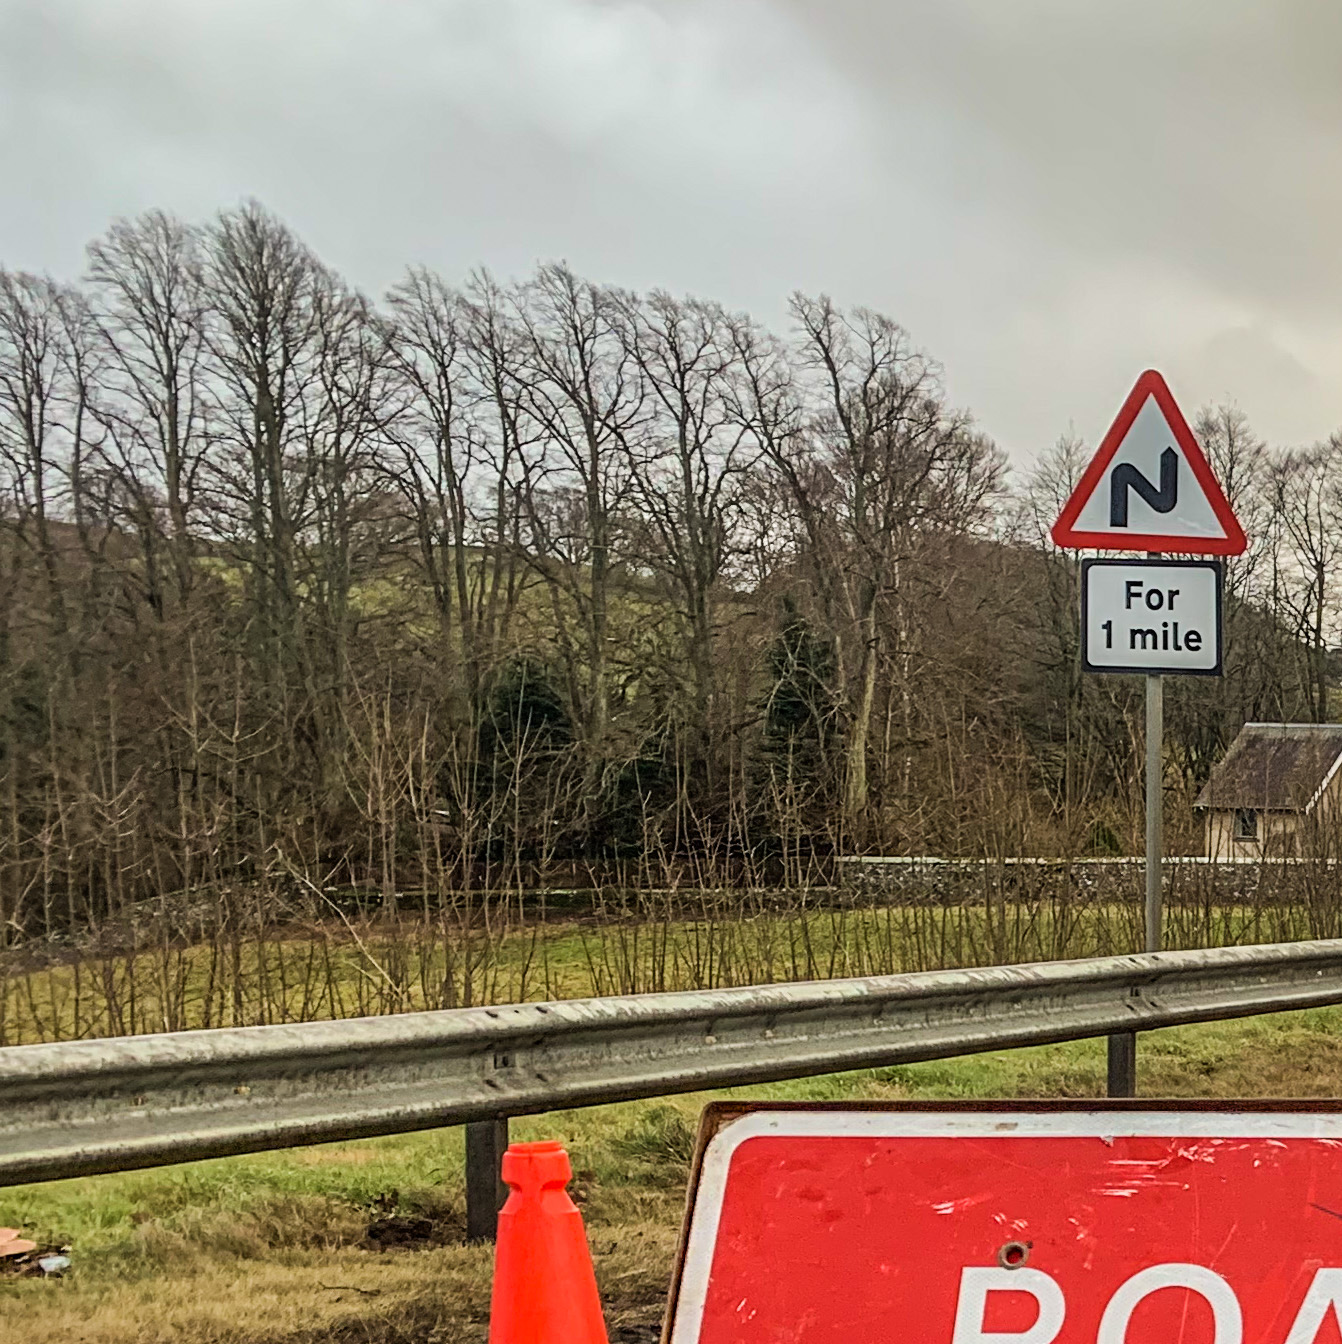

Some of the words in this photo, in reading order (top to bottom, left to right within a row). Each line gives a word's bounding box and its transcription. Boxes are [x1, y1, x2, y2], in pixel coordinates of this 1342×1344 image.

[1124, 580, 1180, 611] For
[1101, 619, 1113, 649] 1
[1129, 621, 1202, 652] mile
